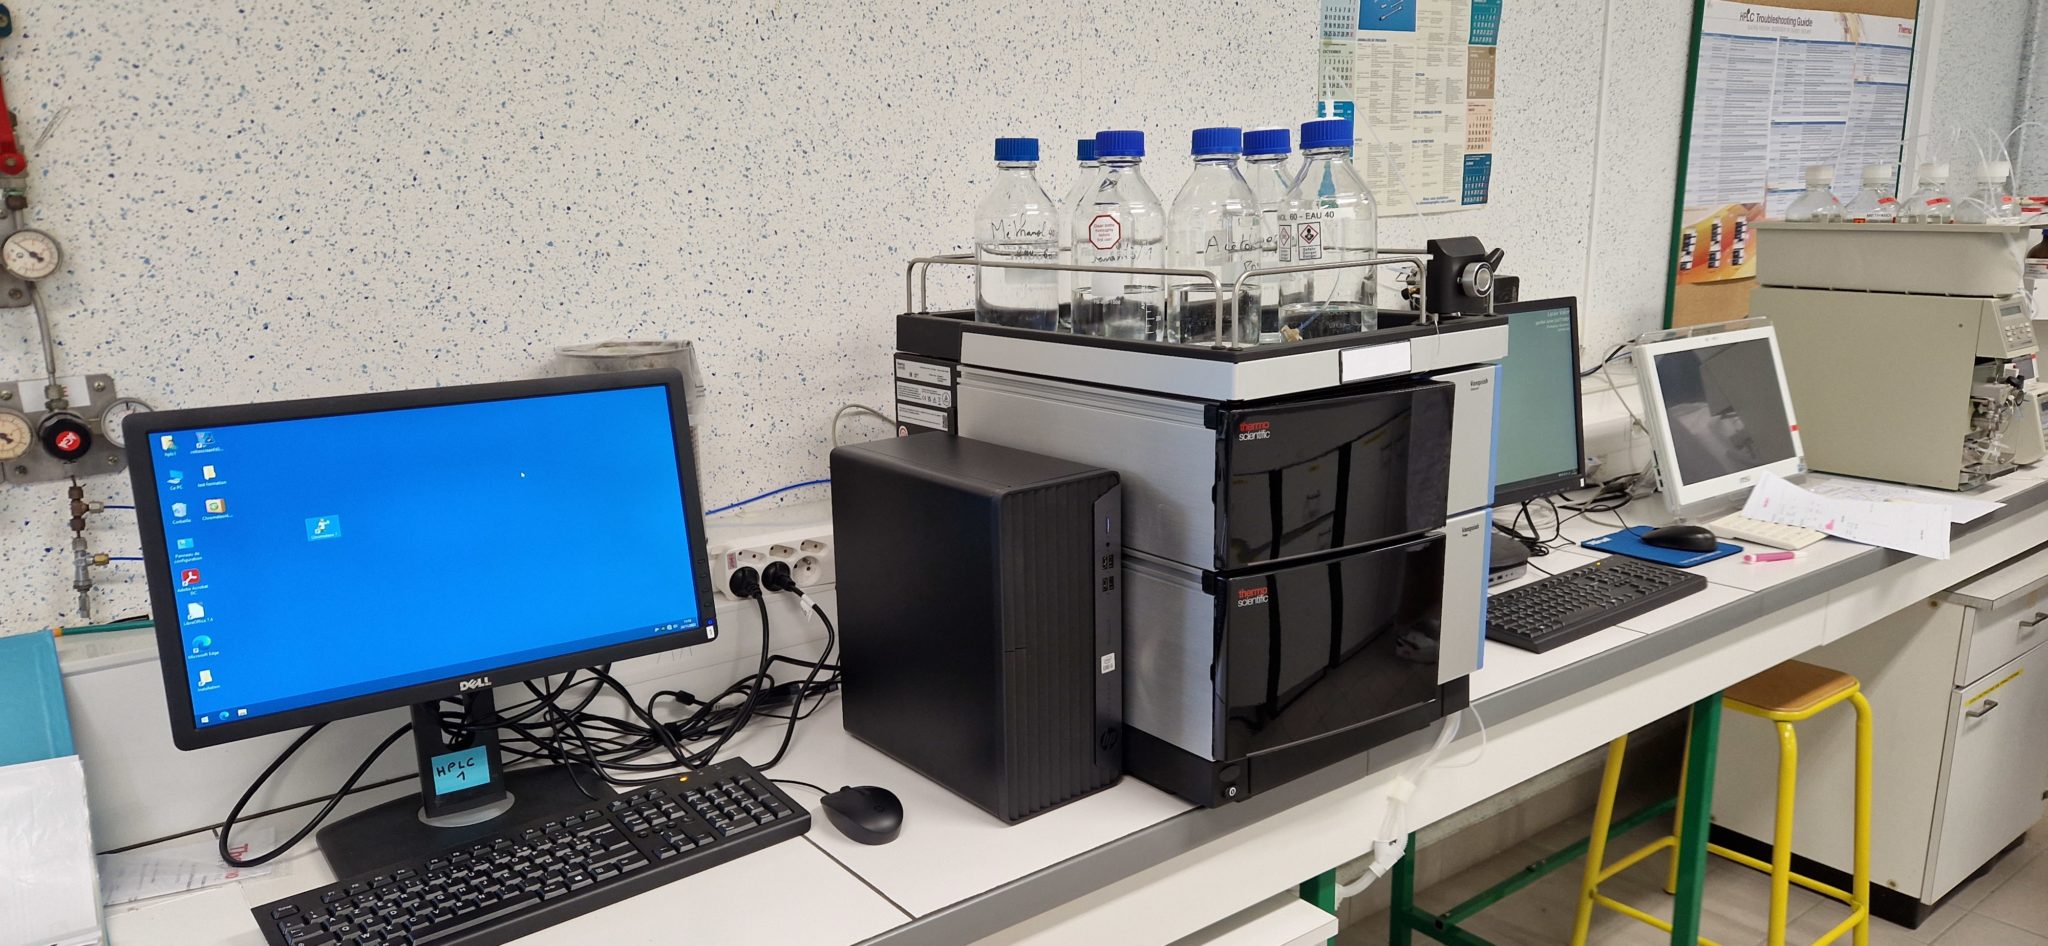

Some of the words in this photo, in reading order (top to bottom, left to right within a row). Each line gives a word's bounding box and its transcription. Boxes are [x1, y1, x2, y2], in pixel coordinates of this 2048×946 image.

[1740, 9, 1754, 22] HPLC
[1756, 13, 1797, 27] Troubleshooting
[1797, 17, 1813, 27] Guide
[1305, 212, 1322, 220] EAU
[1240, 421, 1270, 432] thermo
[1239, 430, 1270, 441] scientific
[1238, 587, 1268, 599] thermo
[1237, 595, 1269, 608] scientific
[460, 676, 492, 691] DELL
[436, 757, 475, 777] HPLC
[456, 771, 466, 781] 1
